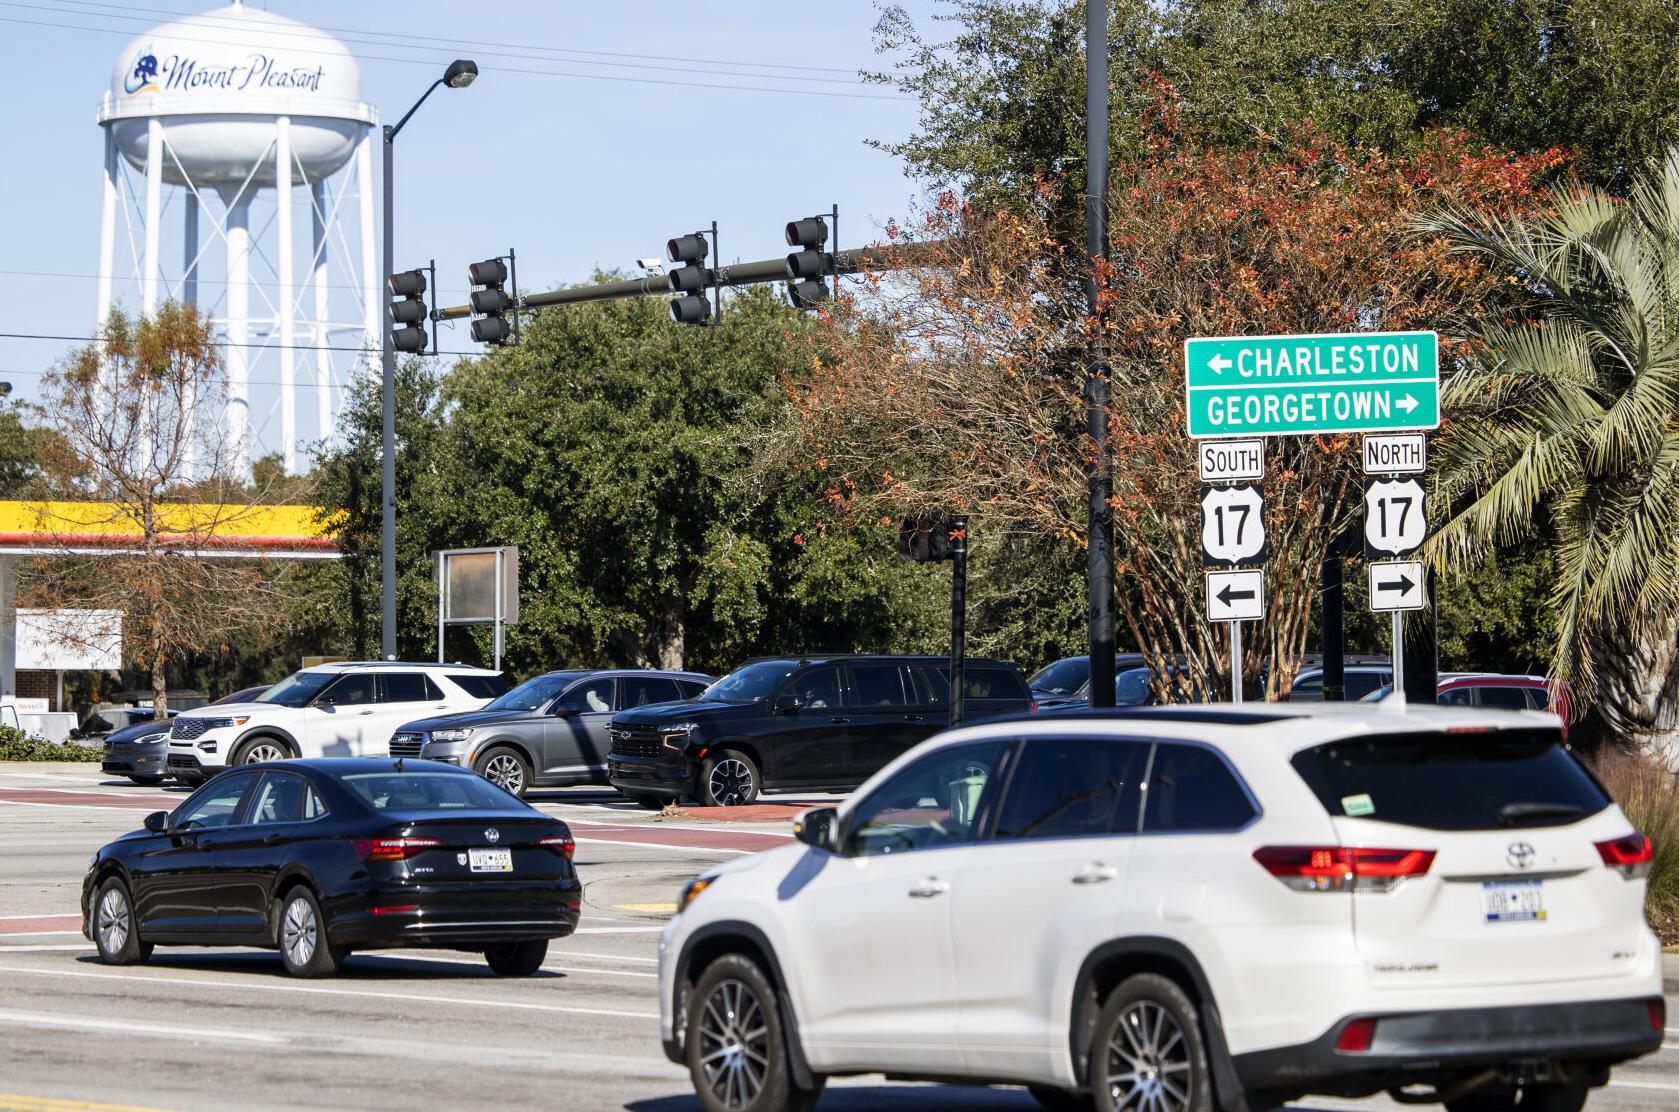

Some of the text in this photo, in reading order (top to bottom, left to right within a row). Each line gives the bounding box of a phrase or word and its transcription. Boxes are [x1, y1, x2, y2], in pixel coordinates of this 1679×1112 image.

[163, 53, 326, 92] Mount Pleasant
[1237, 343, 1419, 378] CHARLESTON
[1208, 390, 1391, 425] GEORGETOWN
[1204, 448, 1259, 473] SOUTH
[1368, 441, 1420, 466] NORTH
[1214, 504, 1251, 547] 17
[1377, 496, 1413, 538] 17
